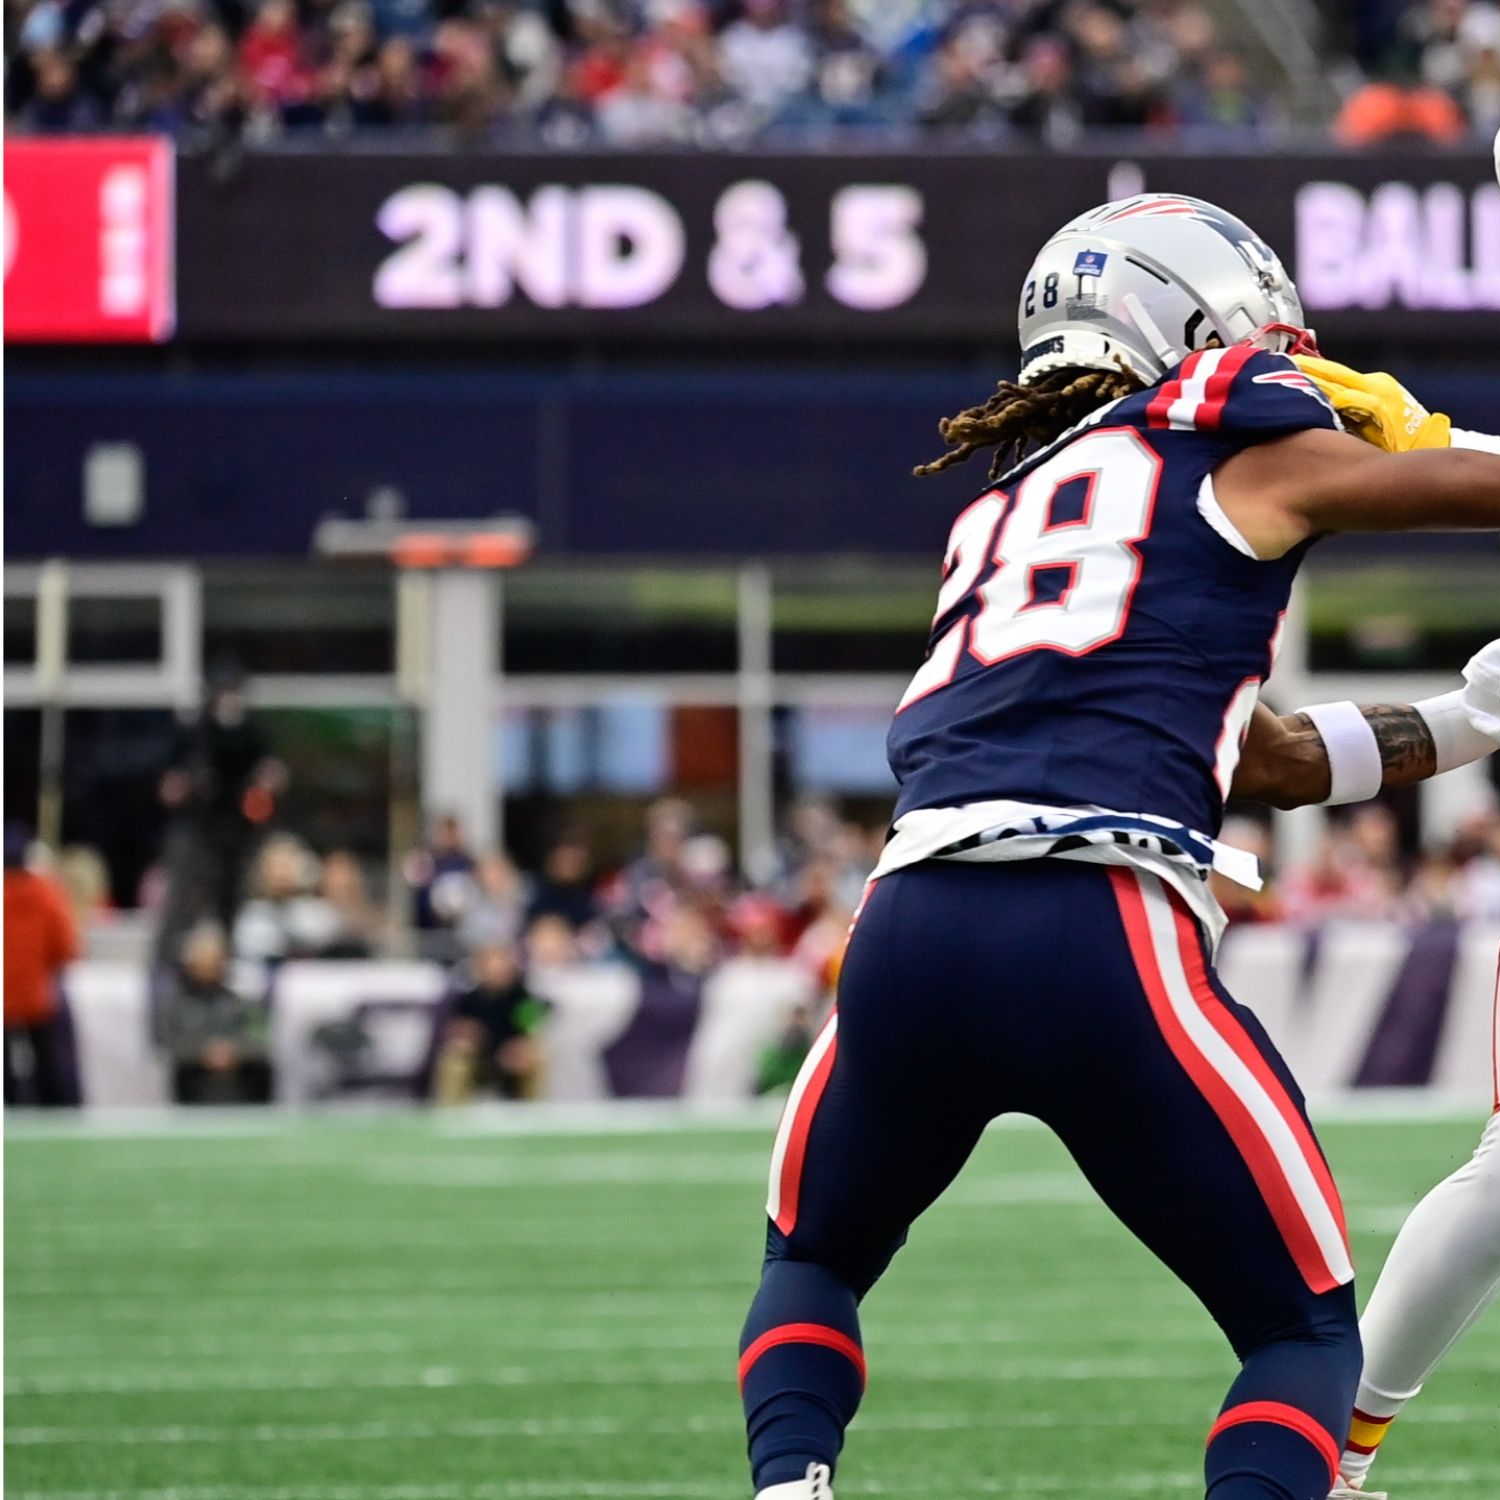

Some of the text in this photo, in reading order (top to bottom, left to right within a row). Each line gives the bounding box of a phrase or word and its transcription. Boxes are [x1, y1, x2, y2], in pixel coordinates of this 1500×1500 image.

[373, 184, 688, 309] 2ND
[707, 180, 804, 309] &
[826, 184, 927, 309] 5
[1025, 272, 1059, 318] 28
[895, 425, 1163, 718] 28
